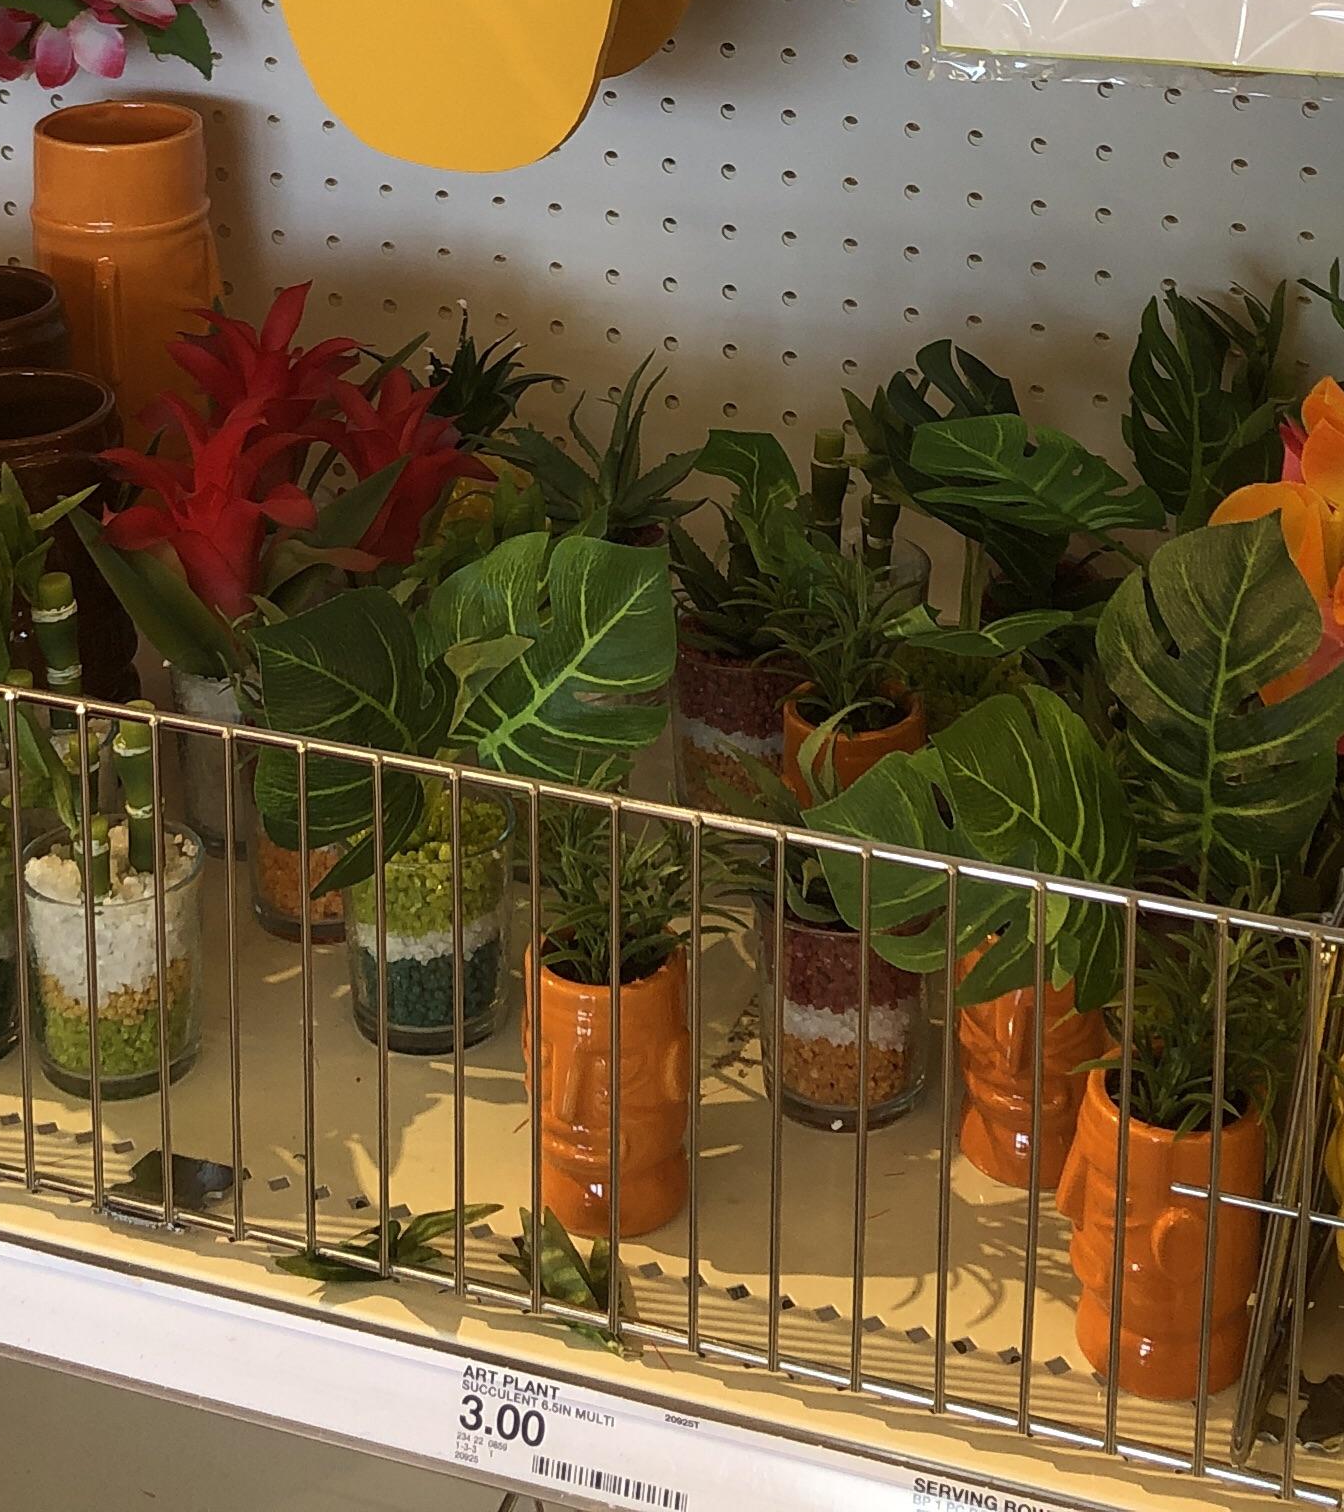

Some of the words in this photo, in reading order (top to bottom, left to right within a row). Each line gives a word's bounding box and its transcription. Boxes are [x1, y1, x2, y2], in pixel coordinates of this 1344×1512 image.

[462, 1364, 499, 1386] ART
[502, 1374, 560, 1400] PLANT
[459, 1395, 546, 1448] 3.00
[462, 1379, 538, 1409] SUCCULENT
[541, 1399, 572, 1417] 6.5IN
[575, 1408, 616, 1428] MULTI
[912, 1493, 931, 1505] BP
[913, 1477, 998, 1512] SERVING
